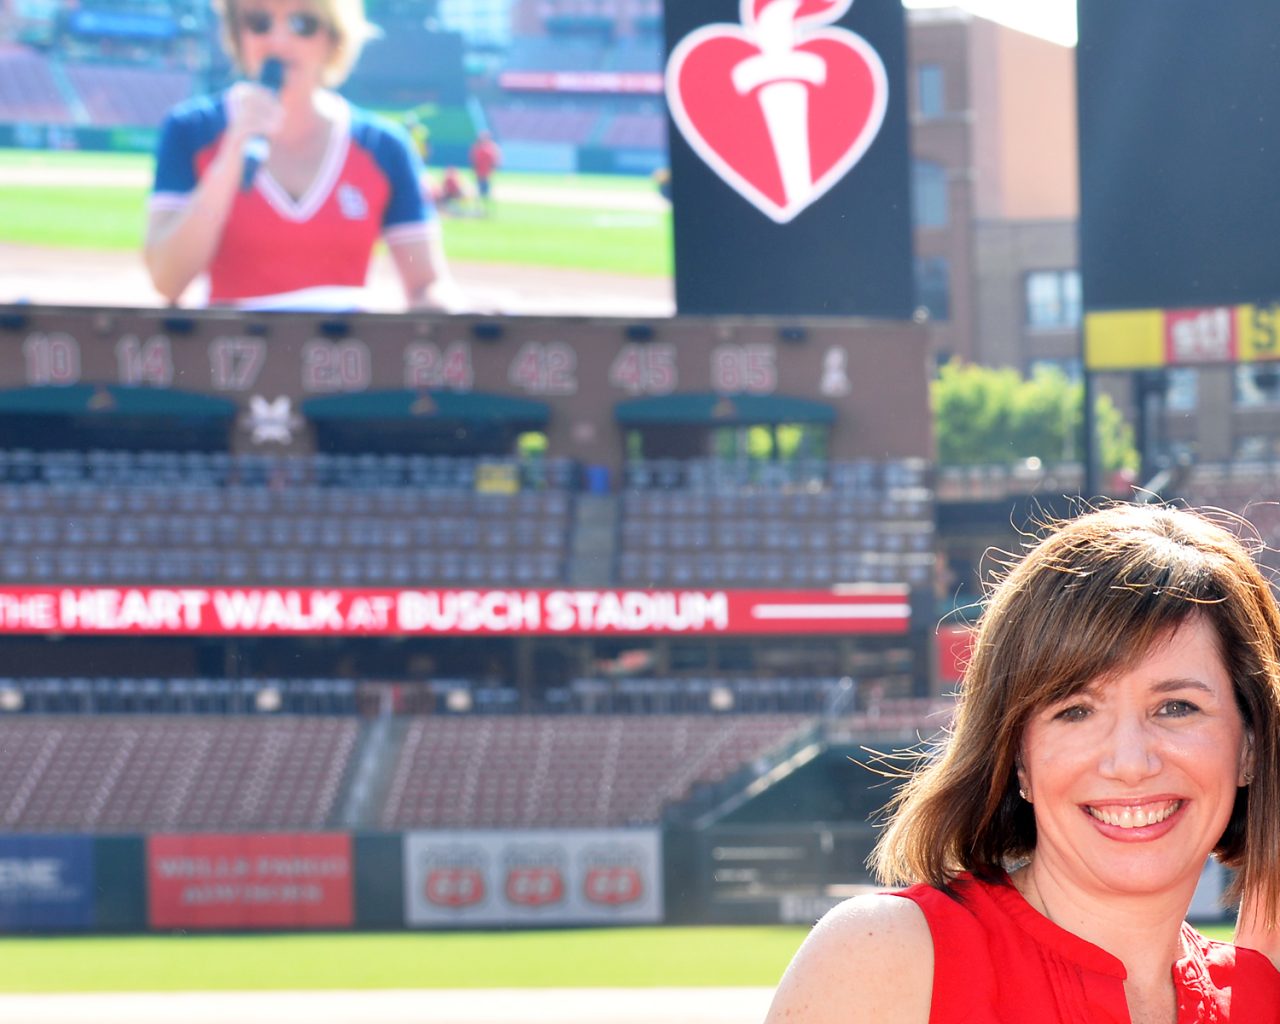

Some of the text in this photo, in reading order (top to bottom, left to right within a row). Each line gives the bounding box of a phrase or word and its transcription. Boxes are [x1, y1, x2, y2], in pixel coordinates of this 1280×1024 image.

[25, 333, 78, 385] 10
[118, 336, 171, 388] 14
[210, 337, 265, 390] 17
[303, 339, 370, 391] 20
[405, 340, 474, 391] 24
[509, 342, 577, 394] 42
[610, 343, 677, 394] 45
[712, 344, 776, 395] 85
[62, 591, 208, 629] HEART
[215, 591, 343, 629] WALK
[347, 598, 392, 629] AT
[399, 593, 539, 630] BUSCH
[546, 593, 728, 630] STADIUM
